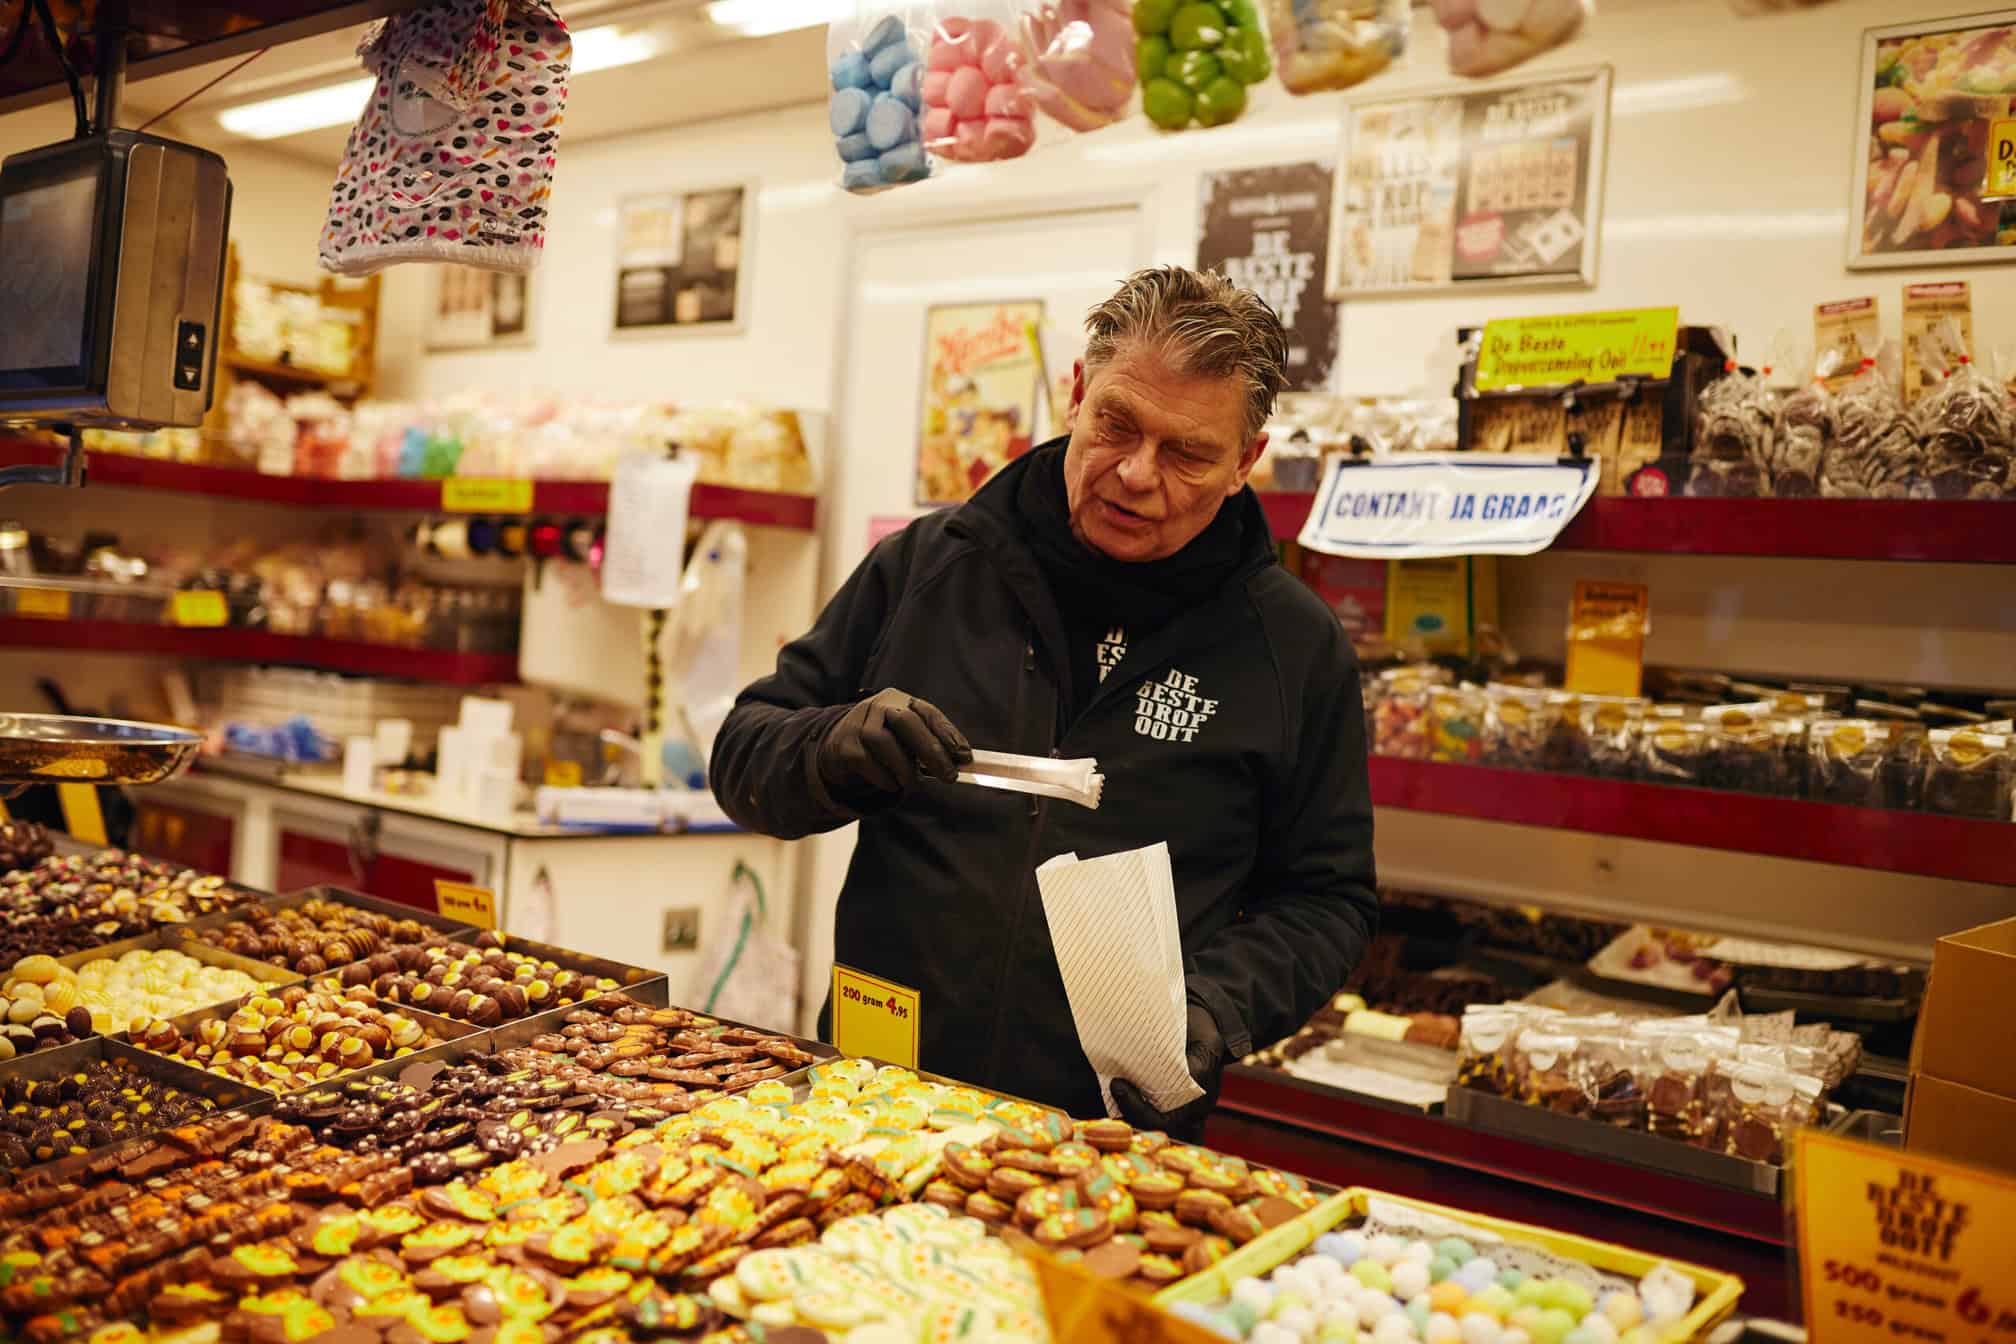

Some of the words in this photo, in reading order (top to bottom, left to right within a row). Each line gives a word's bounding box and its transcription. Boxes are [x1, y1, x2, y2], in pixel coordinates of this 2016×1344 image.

[1335, 492, 1440, 519] CONTANT
[1450, 494, 1474, 520] JA
[1164, 668, 1199, 695] DE
[1136, 680, 1219, 715] BESTE
[1134, 715, 1200, 743] OOIT
[1135, 698, 1208, 729] DROP
[842, 986, 861, 1002] 200
[862, 994, 883, 1009] gram
[886, 997, 908, 1019] 4,95
[1823, 1259, 1881, 1293] 500
